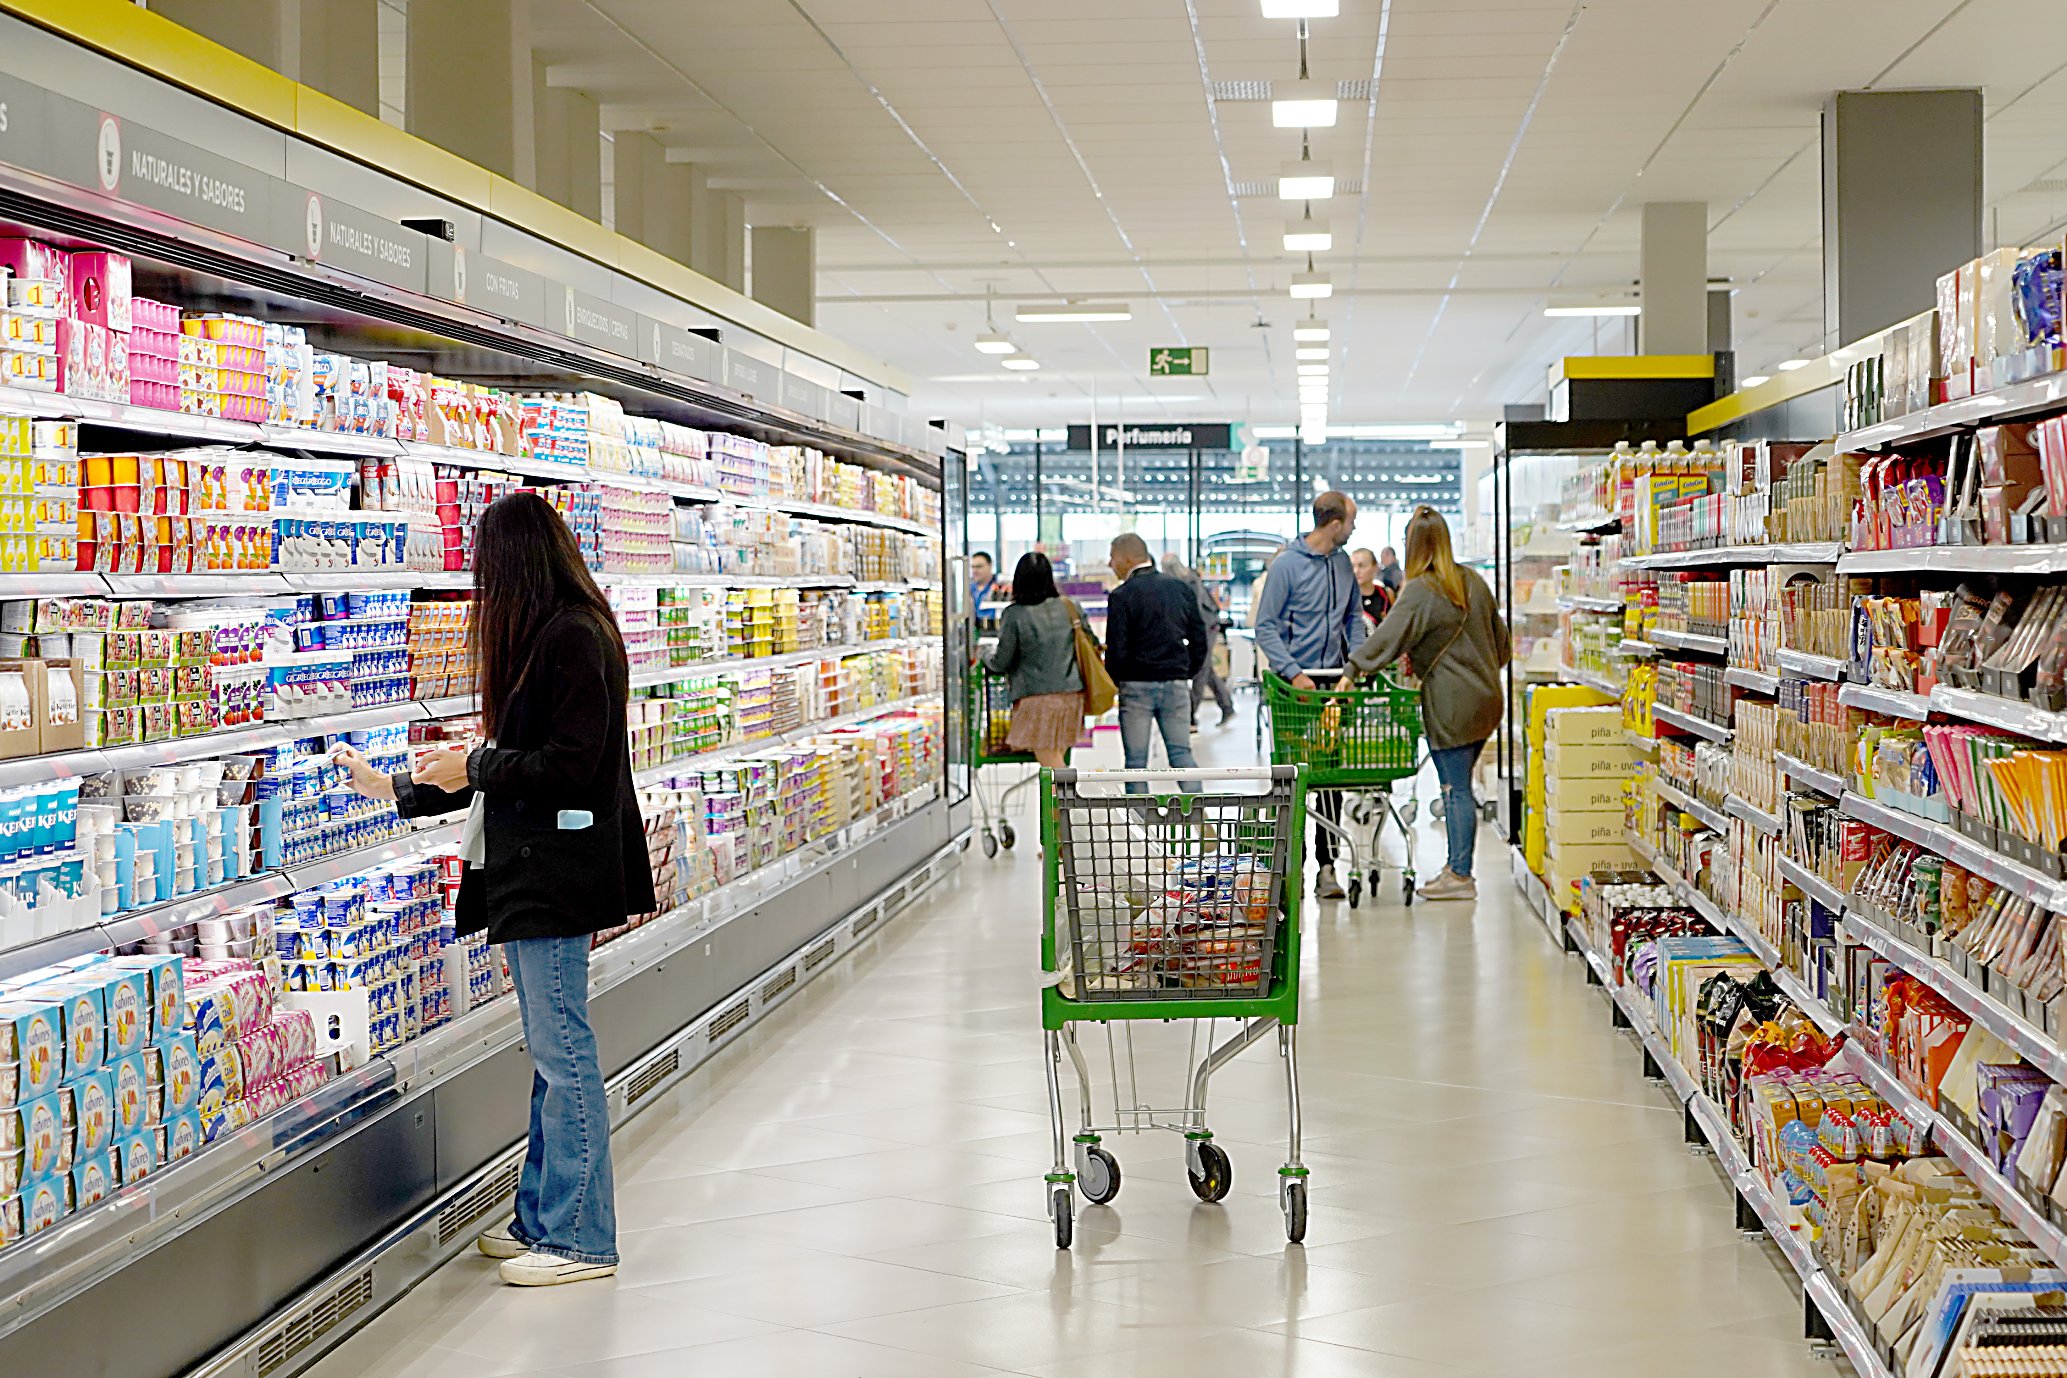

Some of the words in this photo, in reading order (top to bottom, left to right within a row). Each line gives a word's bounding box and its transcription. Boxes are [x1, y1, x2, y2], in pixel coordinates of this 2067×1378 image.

[132, 150, 192, 195] NATURALES
[194, 172, 201, 198] Y
[202, 175, 245, 213] SABORES
[330, 221, 372, 255] NATURALES
[373, 236, 379, 257] Y
[380, 238, 411, 268] SABORES
[486, 273, 499, 293] CON
[499, 276, 519, 300] FRUTAS
[1106, 426, 1193, 445] Prfumería
[1591, 728, 1611, 738] piña
[1591, 761, 1611, 772] piña
[1591, 794, 1611, 805] piña
[1591, 827, 1611, 838] piña
[1592, 860, 1612, 872] piña
[1622, 862, 1638, 870] uva
[161, 978, 177, 991] sabores
[115, 993, 136, 1008] sabores
[75, 1010, 95, 1026] sabores
[28, 1028, 50, 1043] sabores
[171, 1055, 190, 1070] sabores
[120, 1073, 137, 1089] sabores
[85, 1095, 104, 1110] sabores
[33, 1116, 51, 1133] sabores
[175, 1131, 193, 1145] sabores
[130, 1152, 149, 1168] sabores
[84, 1176, 103, 1192] sabores
[33, 1203, 55, 1218] sabores
